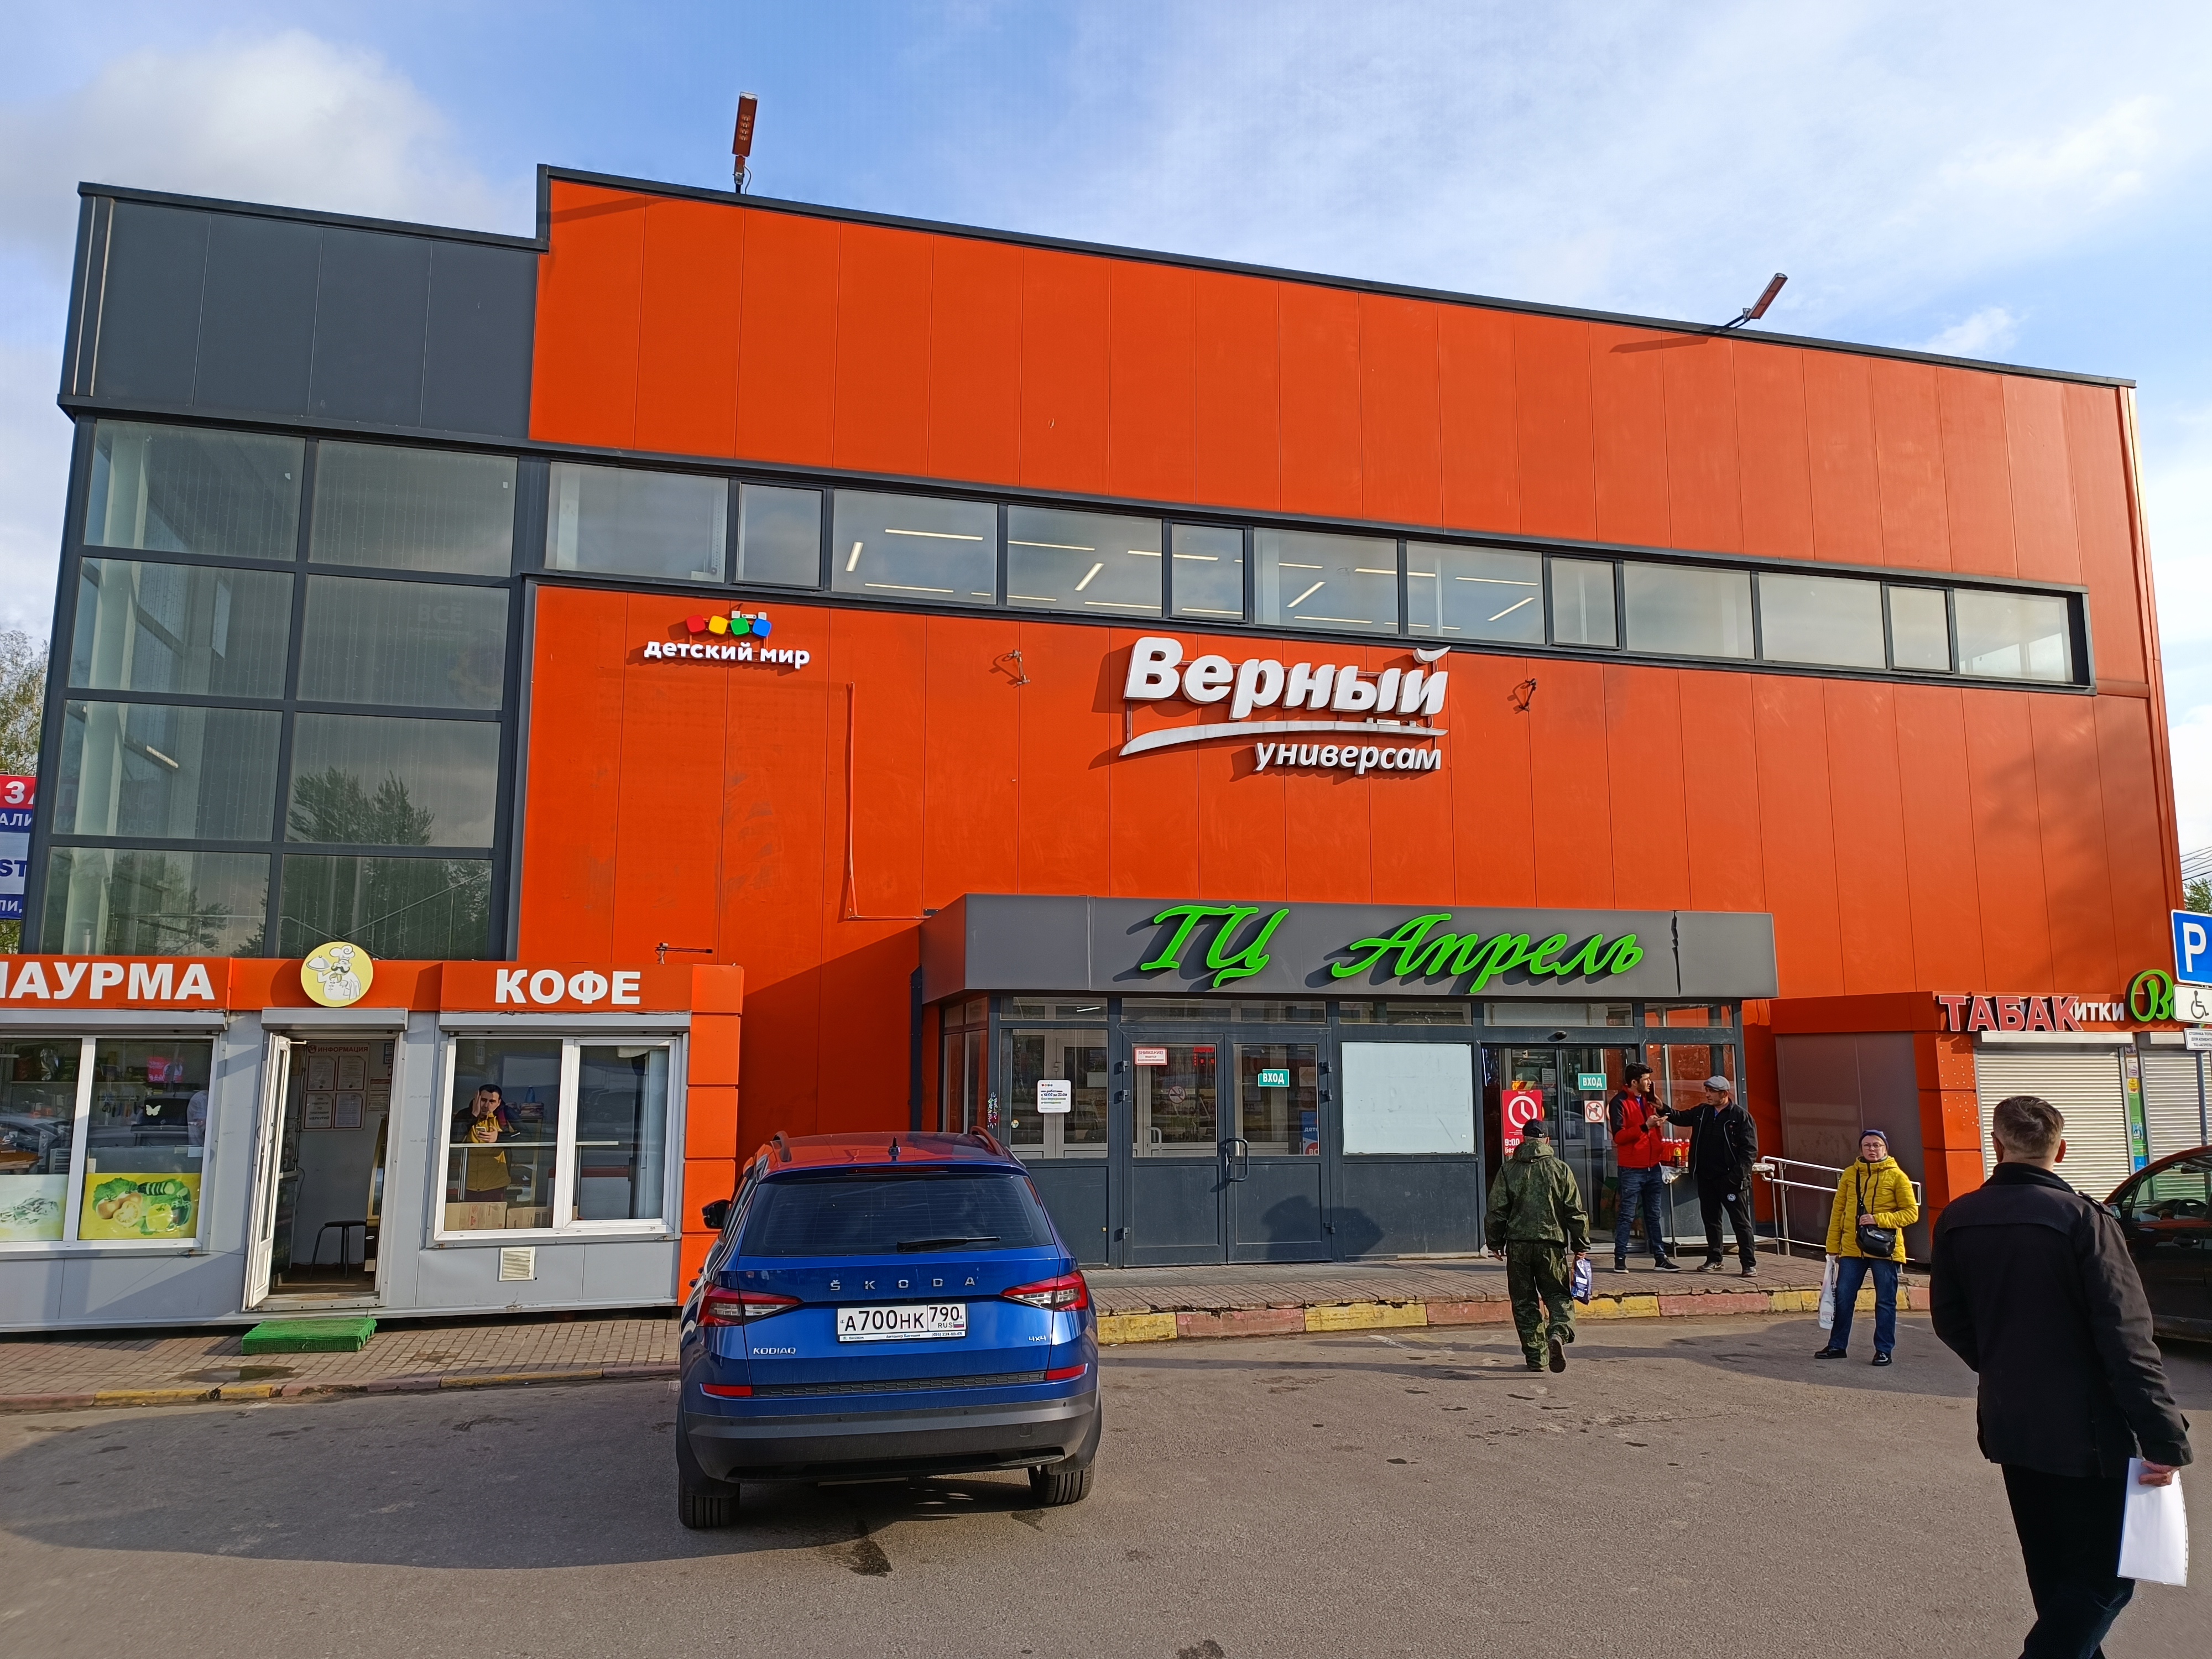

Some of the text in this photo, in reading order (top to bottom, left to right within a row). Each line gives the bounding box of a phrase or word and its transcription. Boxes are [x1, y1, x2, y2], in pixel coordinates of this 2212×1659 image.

[644, 640, 810, 669] детский мир
[1124, 637, 1451, 721] Верный
[1254, 741, 1442, 775] универсам
[1140, 904, 1290, 988] ТЦ
[1331, 912, 1644, 994] Апрель
[2183, 922, 2206, 972] P
[0, 962, 215, 1000] АУРМА
[495, 968, 641, 1005] КОФЕ
[1938, 995, 2084, 1032] ТАБАК
[2074, 1002, 2125, 1022] ИТКИ
[1262, 1073, 1285, 1084] ВХОД
[1582, 1077, 1603, 1088] ВХОД
[1504, 1138, 1520, 1146] 9:00
[830, 1276, 976, 1291] ŠKODA
[844, 1306, 959, 1332] А700НК 790
[753, 1346, 796, 1355] KODIAQ
